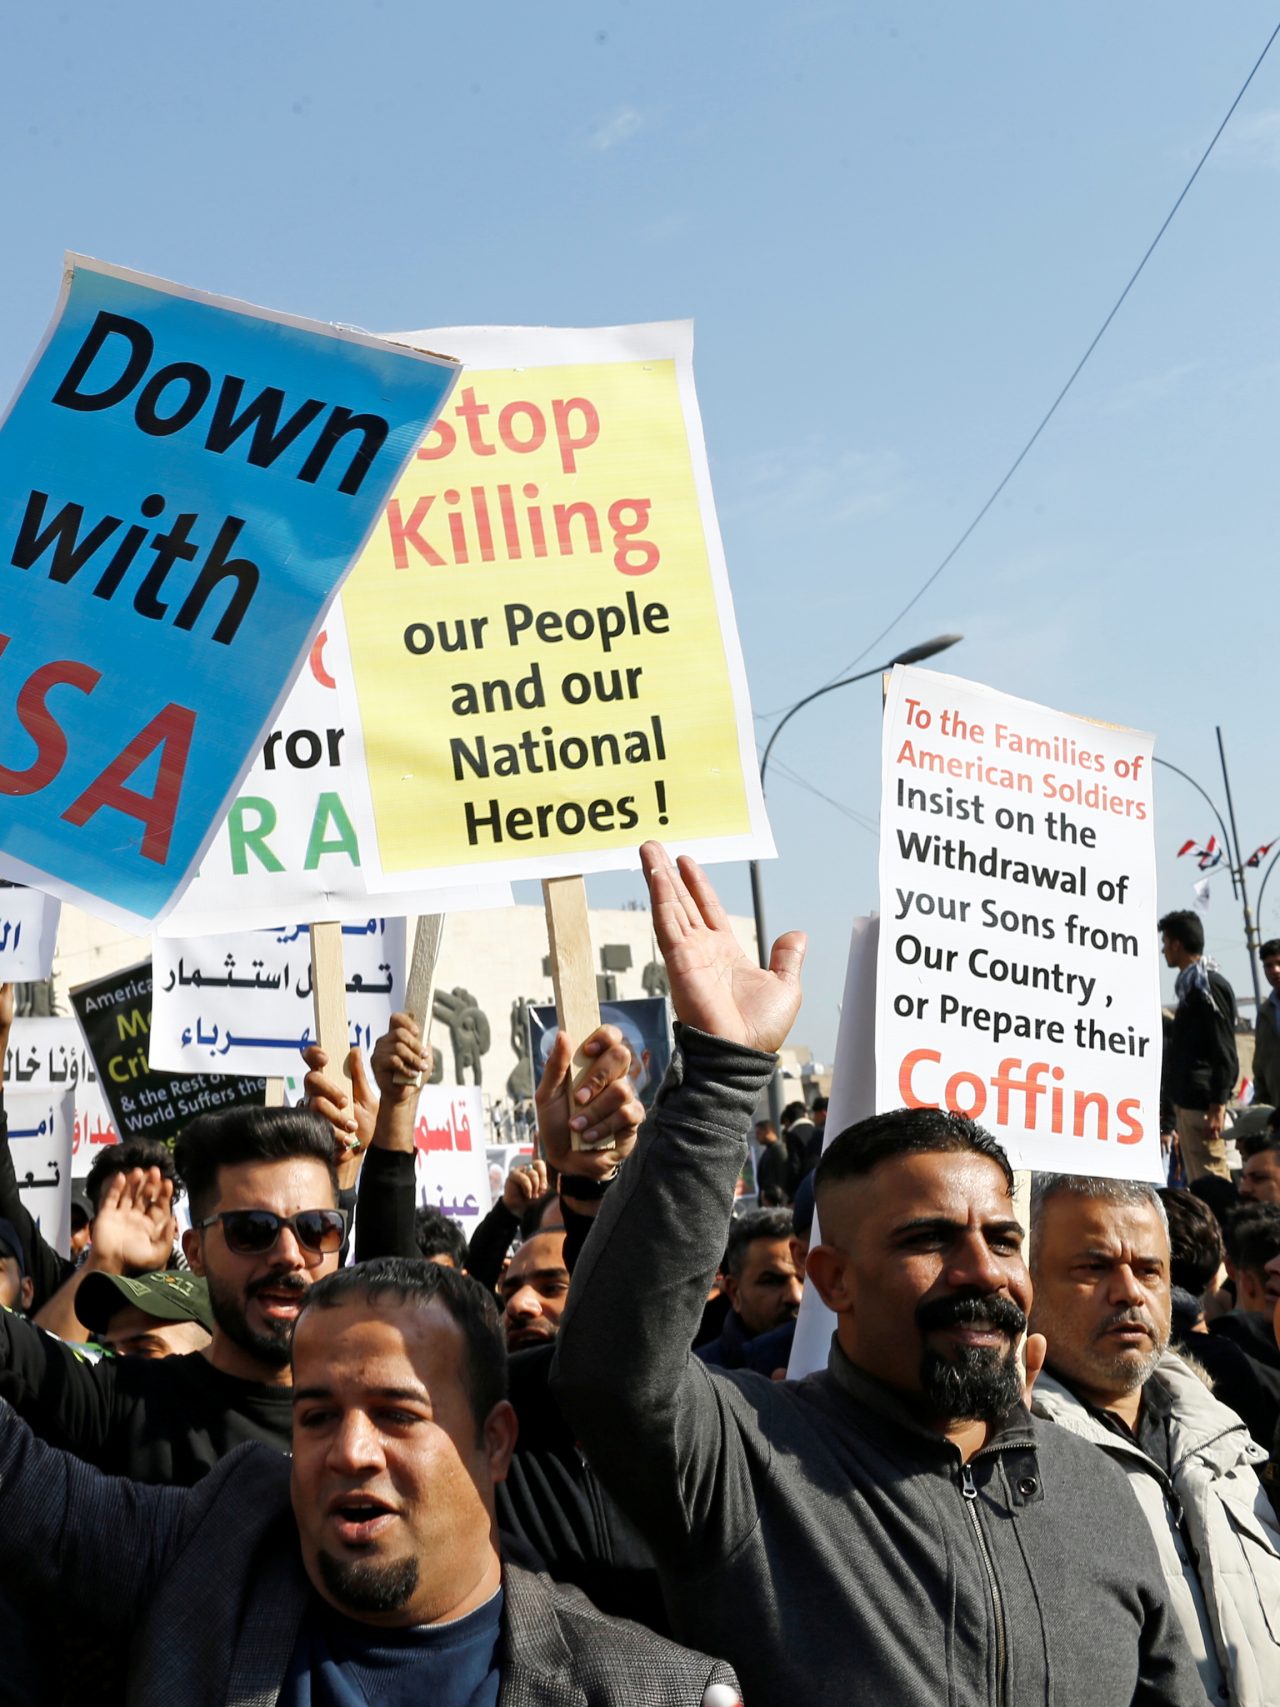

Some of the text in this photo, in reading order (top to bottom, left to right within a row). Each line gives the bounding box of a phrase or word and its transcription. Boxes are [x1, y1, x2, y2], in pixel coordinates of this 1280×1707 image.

[51, 311, 389, 496] Down
[387, 484, 660, 576] Killing
[11, 490, 260, 645] with
[404, 591, 670, 655] our People
[451, 662, 643, 716] and our
[262, 727, 345, 771] ro
[450, 716, 666, 781] National
[905, 698, 1144, 780] To the Families of
[896, 740, 1147, 820] American Soldiers
[897, 778, 1096, 849] Insist on the
[227, 792, 361, 875] RA
[464, 796, 639, 845] Heroes
[896, 829, 1129, 904] Withdrawal of
[895, 887, 1138, 956] your Sons from
[162, 952, 289, 992] استثمار
[895, 934, 958, 972] Our
[968, 949, 1096, 1007] Country
[181, 1016, 371, 1056] الهرباء
[894, 994, 1149, 1057] or Prepare their
[108, 1047, 150, 1083] Cri
[121, 1096, 136, 1112] &
[139, 1088, 168, 1108] the
[170, 1073, 206, 1097] Rest
[898, 1048, 1144, 1145] Coffins
[125, 1078, 267, 1132] World Suffers the
